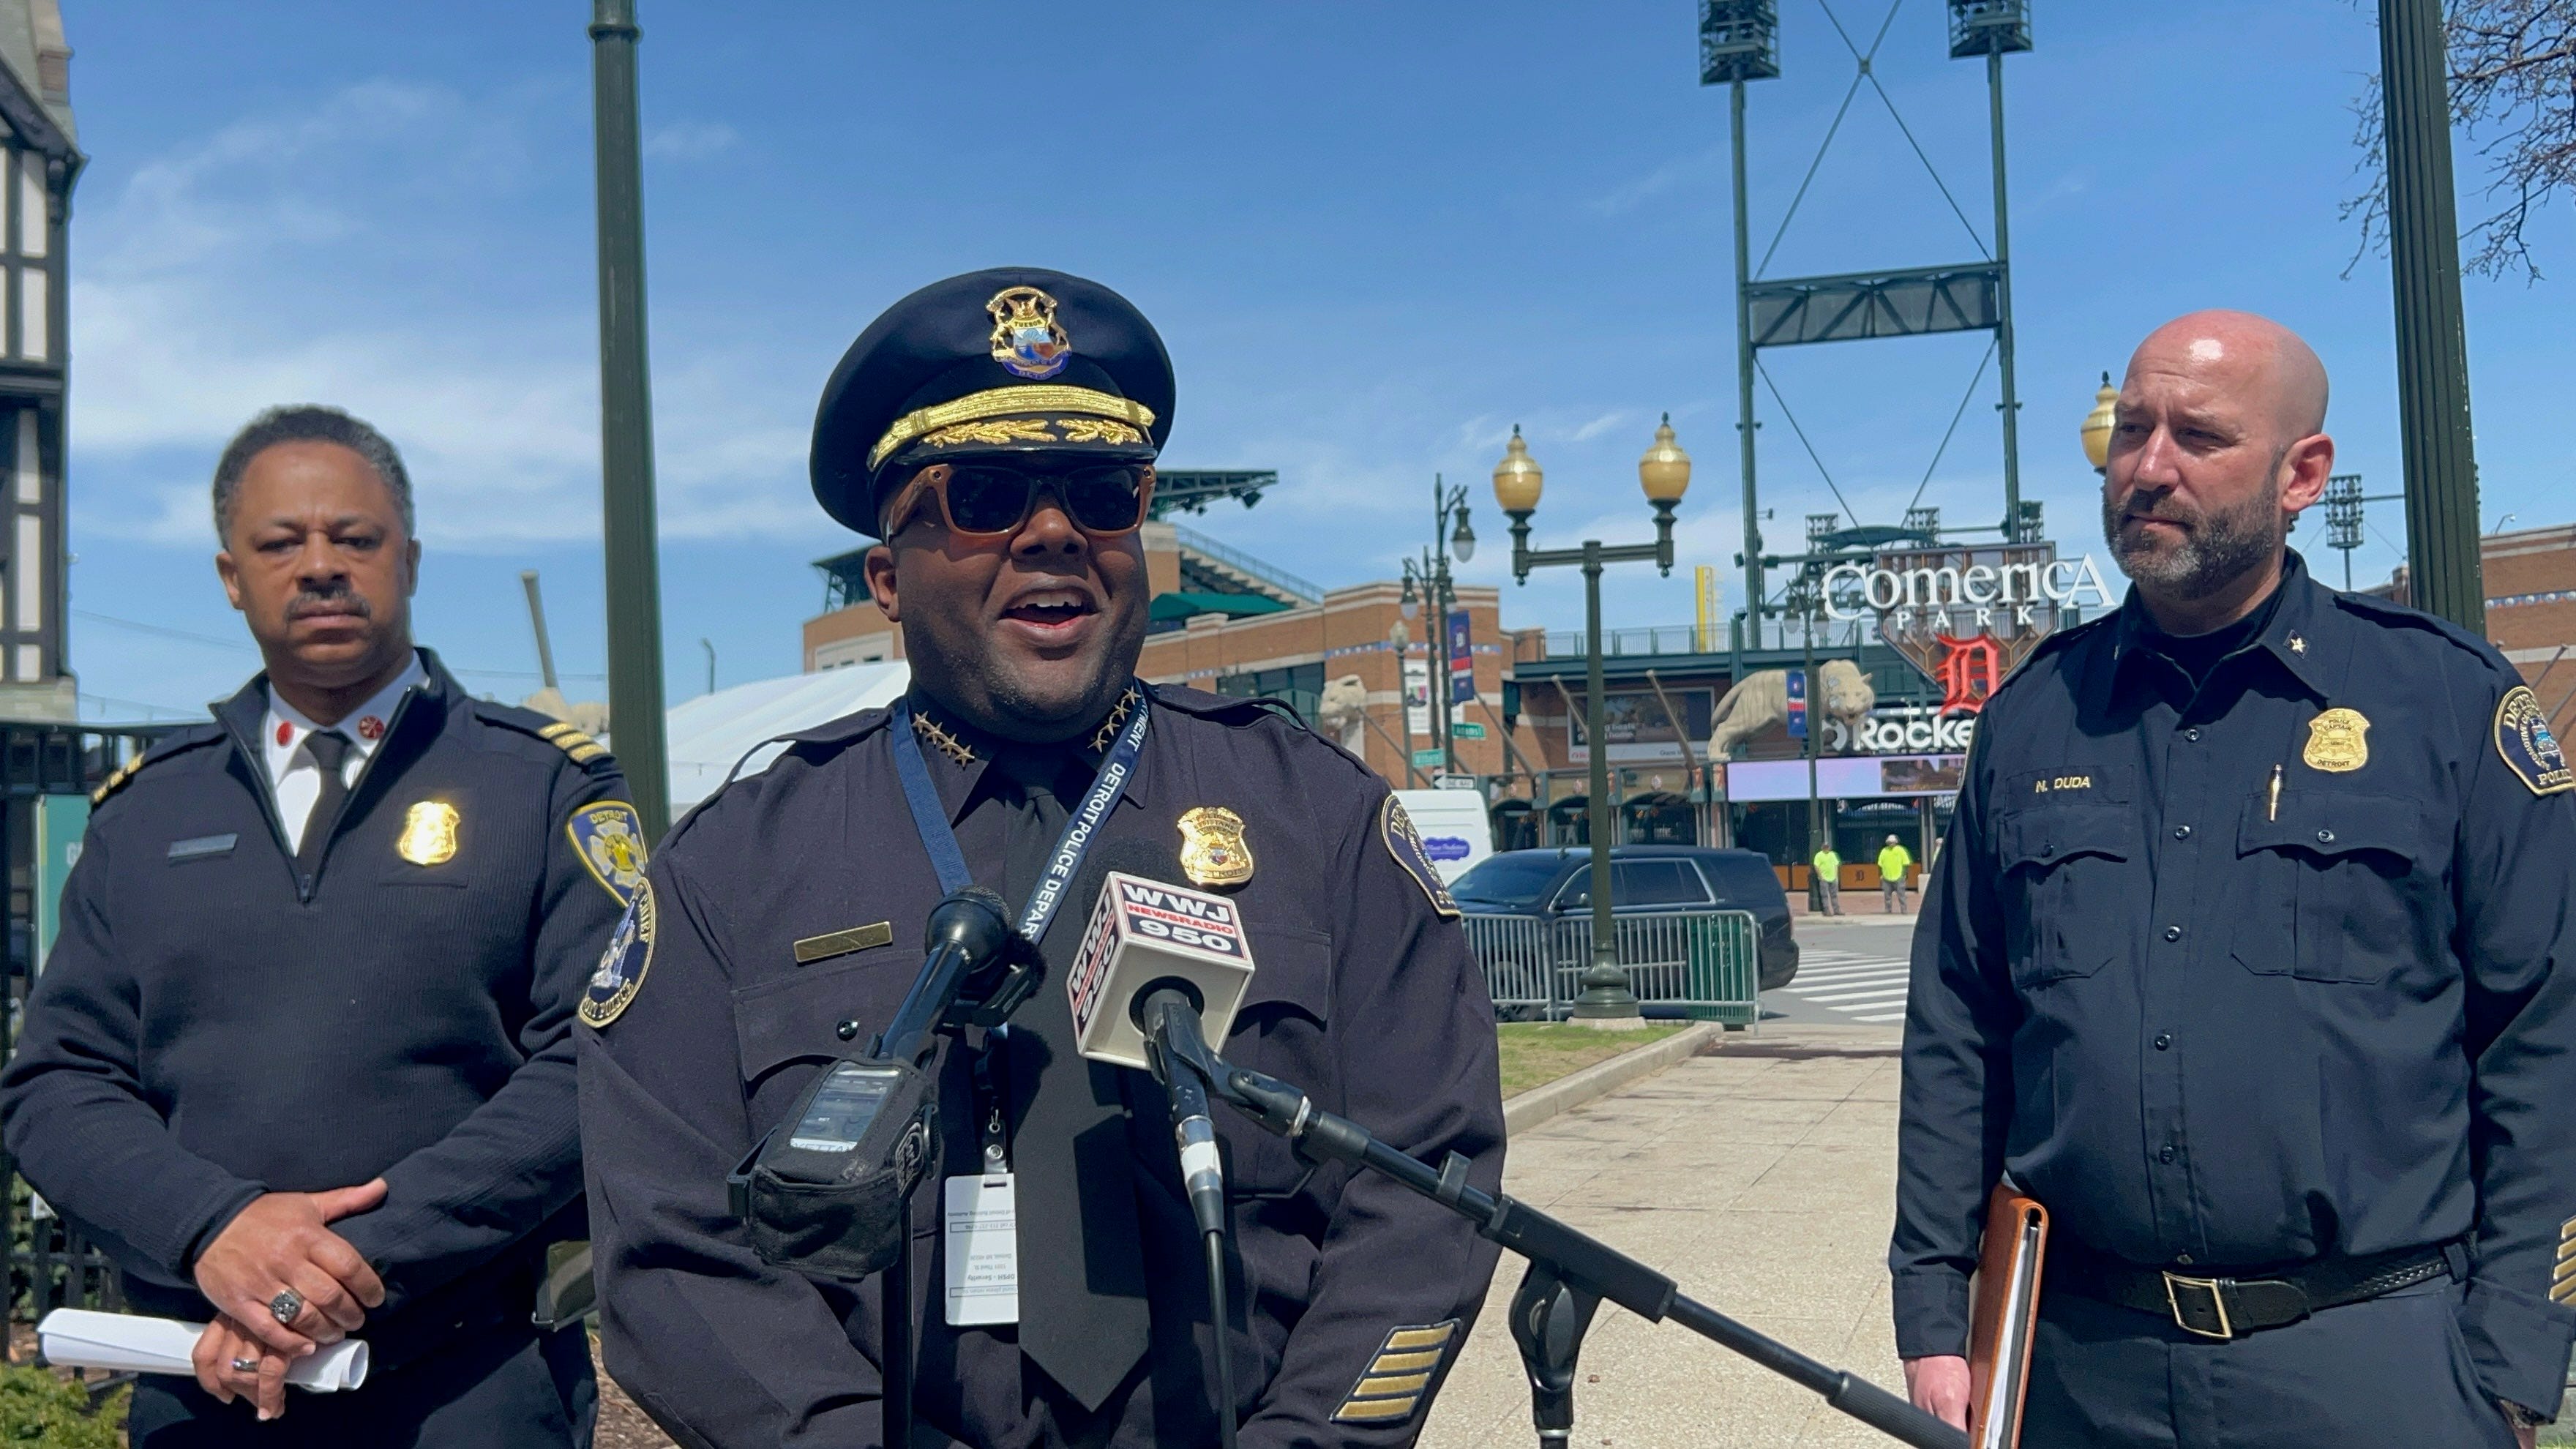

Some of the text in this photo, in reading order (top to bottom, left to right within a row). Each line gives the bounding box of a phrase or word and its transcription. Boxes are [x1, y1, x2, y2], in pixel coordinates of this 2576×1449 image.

[1897, 605, 2034, 630] PARK
[1935, 632, 1999, 717] D
[2503, 694, 2539, 730] DETR
[2317, 759, 2351, 767] DETROIT
[1082, 762, 1126, 825] DETROIT
[2035, 776, 2091, 793] N. DUDA
[589, 810, 628, 823] DETROIT
[1051, 820, 1092, 877] POLICE
[1121, 883, 1230, 922] WWJ
[1128, 905, 1233, 935] NEWSRADIO
[1072, 894, 1112, 993] WWJ
[1139, 919, 1232, 951] 950
[1082, 935, 1115, 1022] 950
